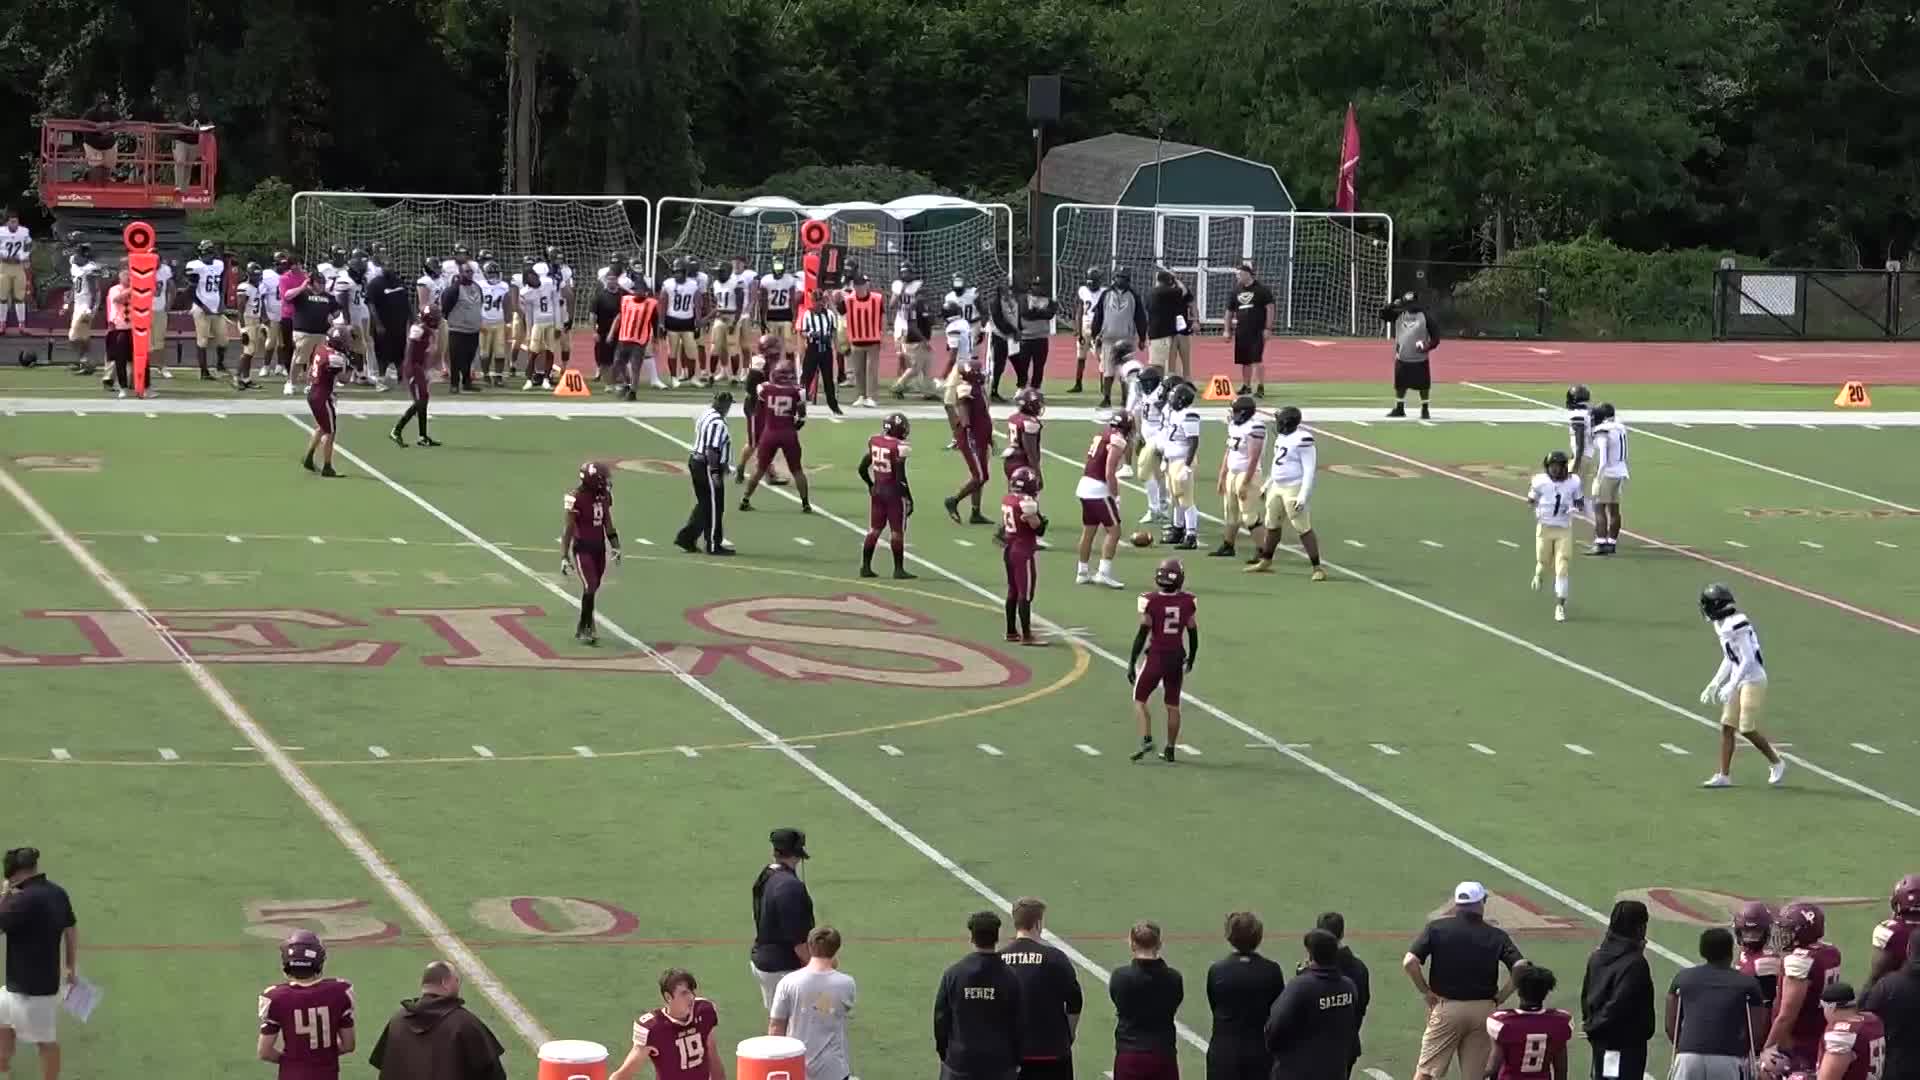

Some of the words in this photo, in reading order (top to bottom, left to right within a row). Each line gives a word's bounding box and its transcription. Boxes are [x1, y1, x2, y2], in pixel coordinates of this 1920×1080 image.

[827, 248, 839, 273] 1
[484, 294, 502, 311] 34
[673, 294, 691, 312] 80
[770, 290, 787, 305] 26
[565, 373, 583, 392] 40
[1214, 379, 1231, 396] 30
[1849, 386, 1864, 402] 20
[767, 396, 793, 416] 42
[872, 445, 892, 473] 25
[1552, 493, 1562, 517] 1
[1163, 606, 1180, 634] 2
[964, 987, 996, 1000] PEREZ
[293, 1005, 331, 1050] 41
[675, 1031, 705, 1070] 19
[1520, 1033, 1548, 1073] 8
